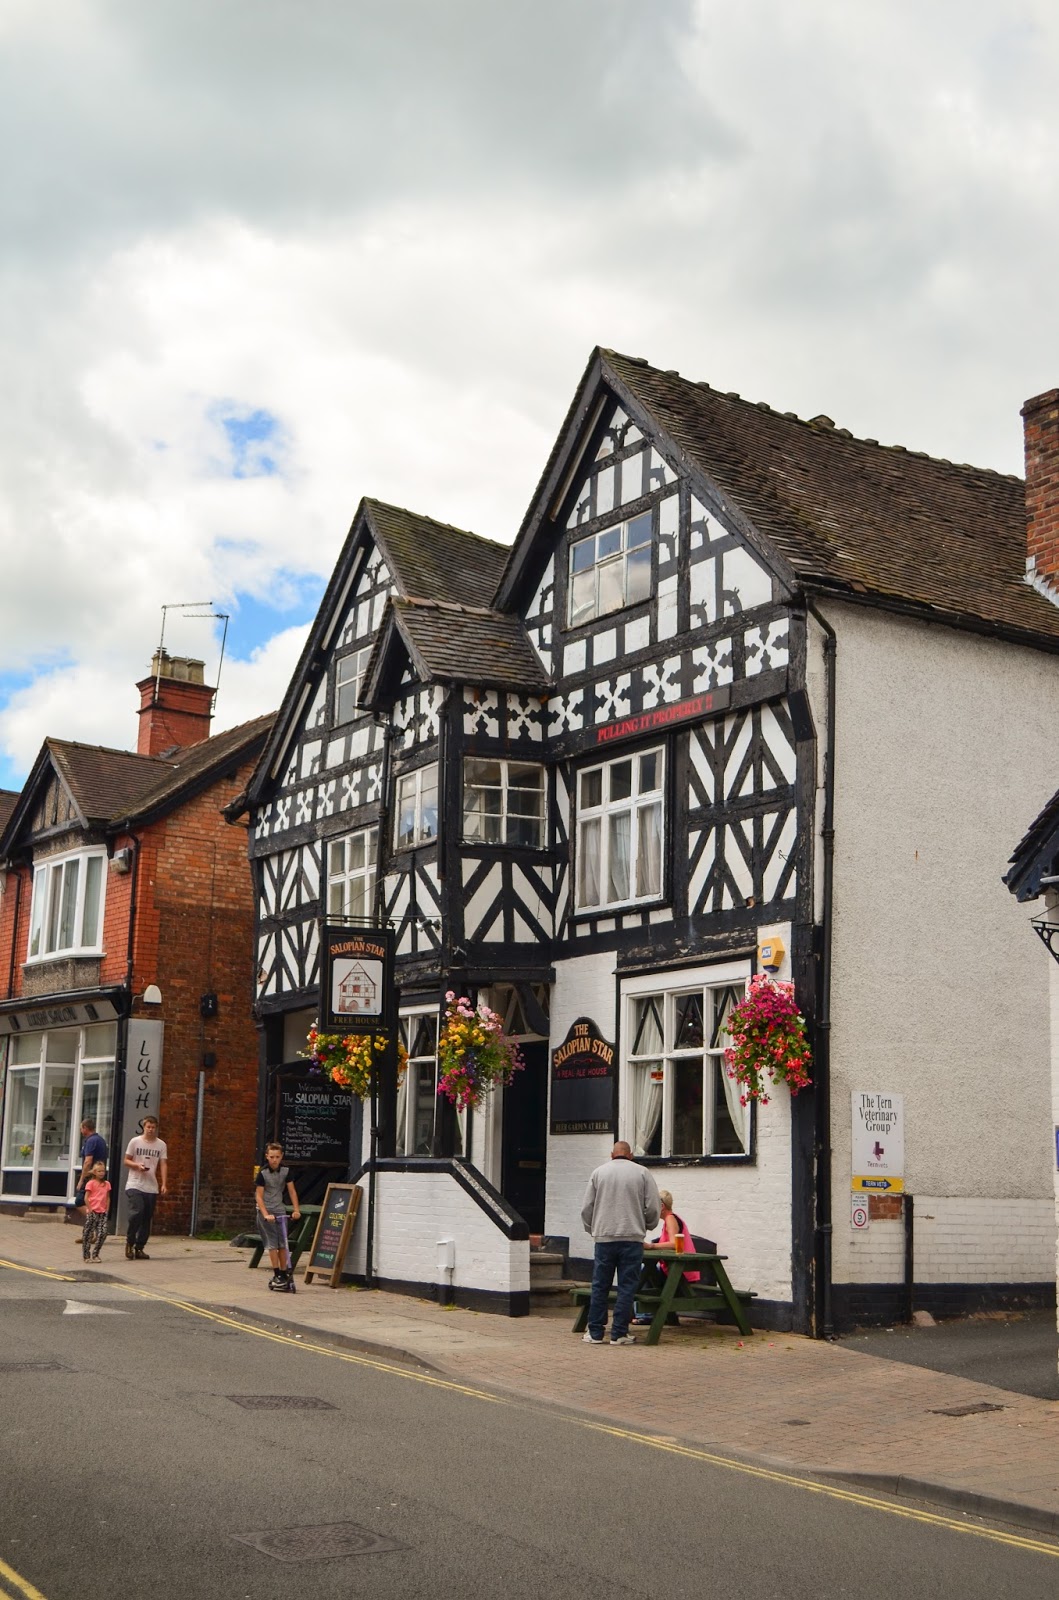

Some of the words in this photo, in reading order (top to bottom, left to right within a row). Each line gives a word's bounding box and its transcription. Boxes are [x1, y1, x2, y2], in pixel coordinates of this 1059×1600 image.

[597, 718, 639, 744] PULLING
[640, 714, 652, 729] IT
[652, 696, 704, 725] PROPERLY
[330, 942, 366, 954] SALOPIAN
[365, 942, 386, 958] STAR
[333, 1016, 354, 1024] FREE
[355, 1016, 381, 1025] HOUSE
[574, 1023, 589, 1037] THE
[553, 1037, 591, 1068] SALOPIAN
[591, 1039, 614, 1066] STAR
[587, 1066, 608, 1076] HOUSE
[295, 1093, 330, 1105] SALOPIAN
[332, 1095, 352, 1106] STAR
[861, 1094, 875, 1108] The
[876, 1095, 892, 1109] Tern
[859, 1107, 898, 1125] Veterinary
[595, 1121, 609, 1130] REAR
[865, 1119, 891, 1135] Group
[136, 1147, 161, 1158] BROOKLYN
[857, 1211, 863, 1221] 5
